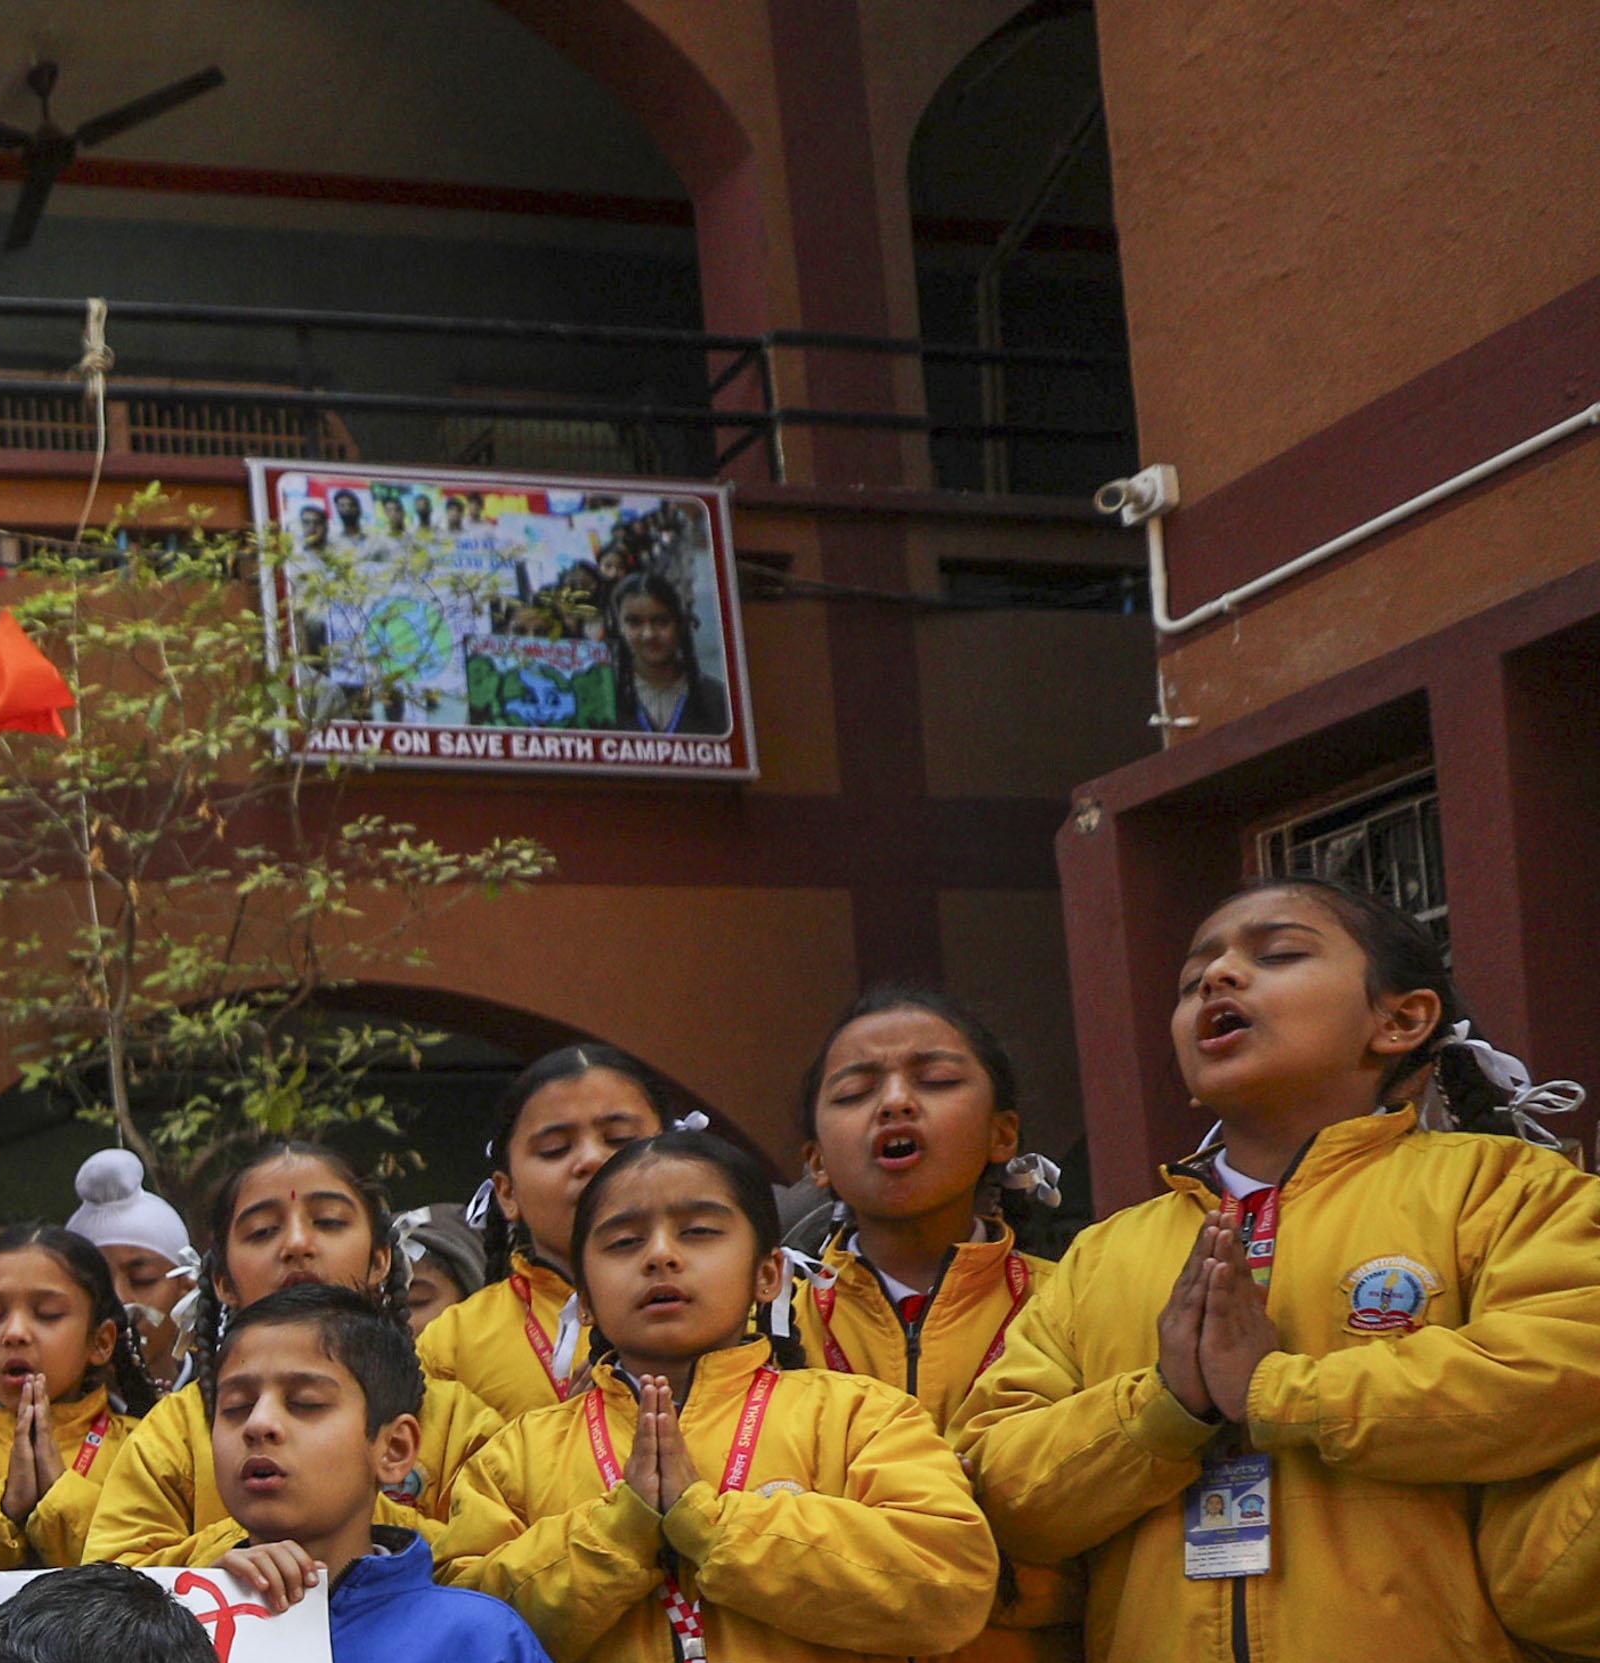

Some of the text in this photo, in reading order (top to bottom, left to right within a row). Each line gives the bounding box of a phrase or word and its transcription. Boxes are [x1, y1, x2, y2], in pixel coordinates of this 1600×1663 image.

[308, 726, 733, 766] RALLY ON SAVE EARTH CAMPAIGN
[738, 1404, 760, 1448] SHIKSHA
